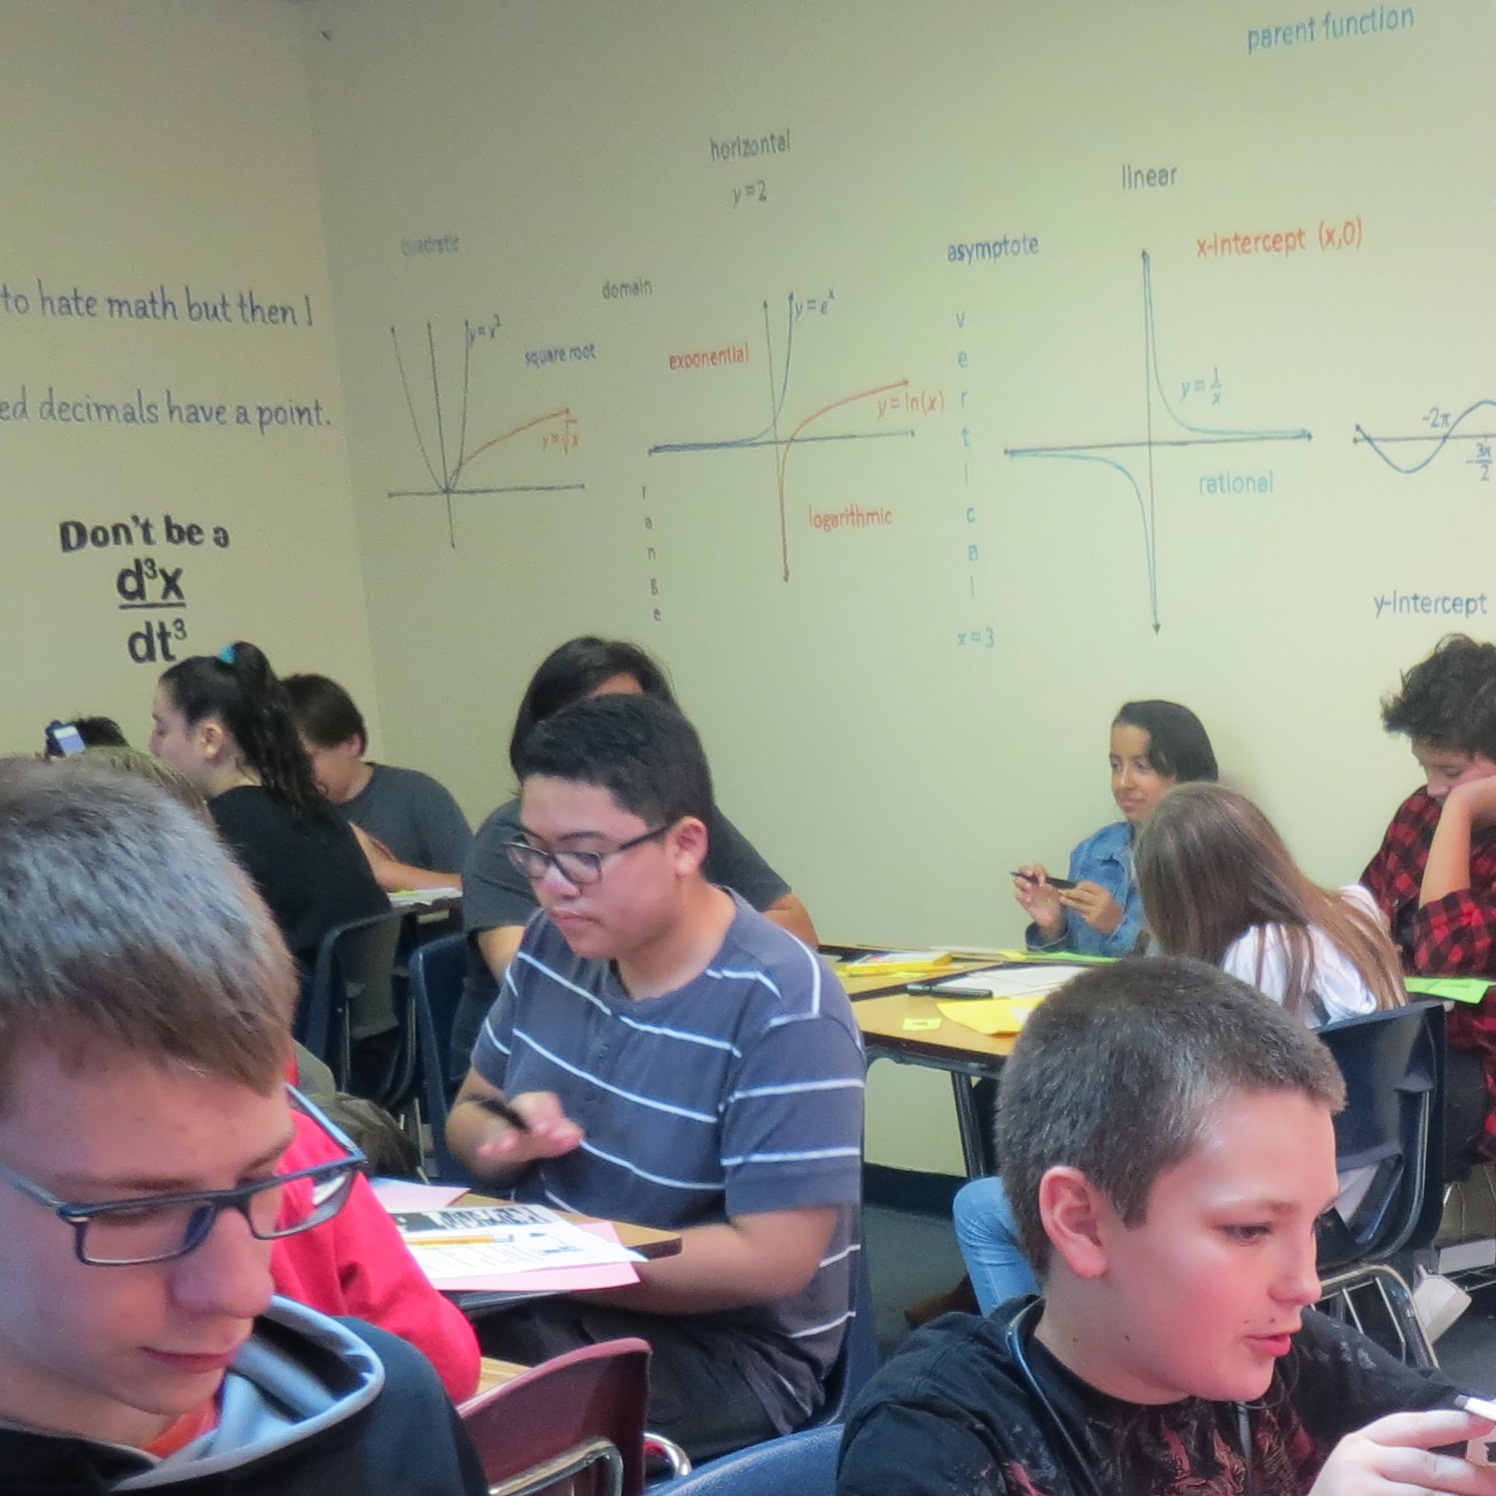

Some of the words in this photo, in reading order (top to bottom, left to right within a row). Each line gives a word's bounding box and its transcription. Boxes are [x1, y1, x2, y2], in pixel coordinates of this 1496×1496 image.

[1246, 17, 1318, 54] parent
[1328, 4, 1416, 41] function
[709, 128, 792, 163] horizontal
[1121, 164, 1178, 191] linear
[401, 234, 460, 257] quadratic
[947, 234, 1039, 266] asymptote
[1196, 225, 1307, 260] x-intercept
[1318, 216, 1363, 253] (x,0)
[1, 284, 29, 316] to
[37, 279, 99, 318] hate
[106, 285, 178, 322] math
[187, 285, 233, 323] but
[238, 289, 298, 327] then
[601, 278, 653, 300] domain
[525, 346, 566, 368] square
[570, 342, 596, 361] root
[668, 343, 750, 371] exponential
[39, 388, 160, 425] decimals
[165, 390, 229, 427] have
[235, 404, 252, 427] a
[257, 400, 333, 435] point.
[1199, 470, 1273, 497] rational
[808, 504, 894, 531] logarithmic
[58, 514, 158, 553] Don't
[164, 516, 205, 547] be
[212, 526, 230, 548] a
[1374, 590, 1489, 618] y-intercept
